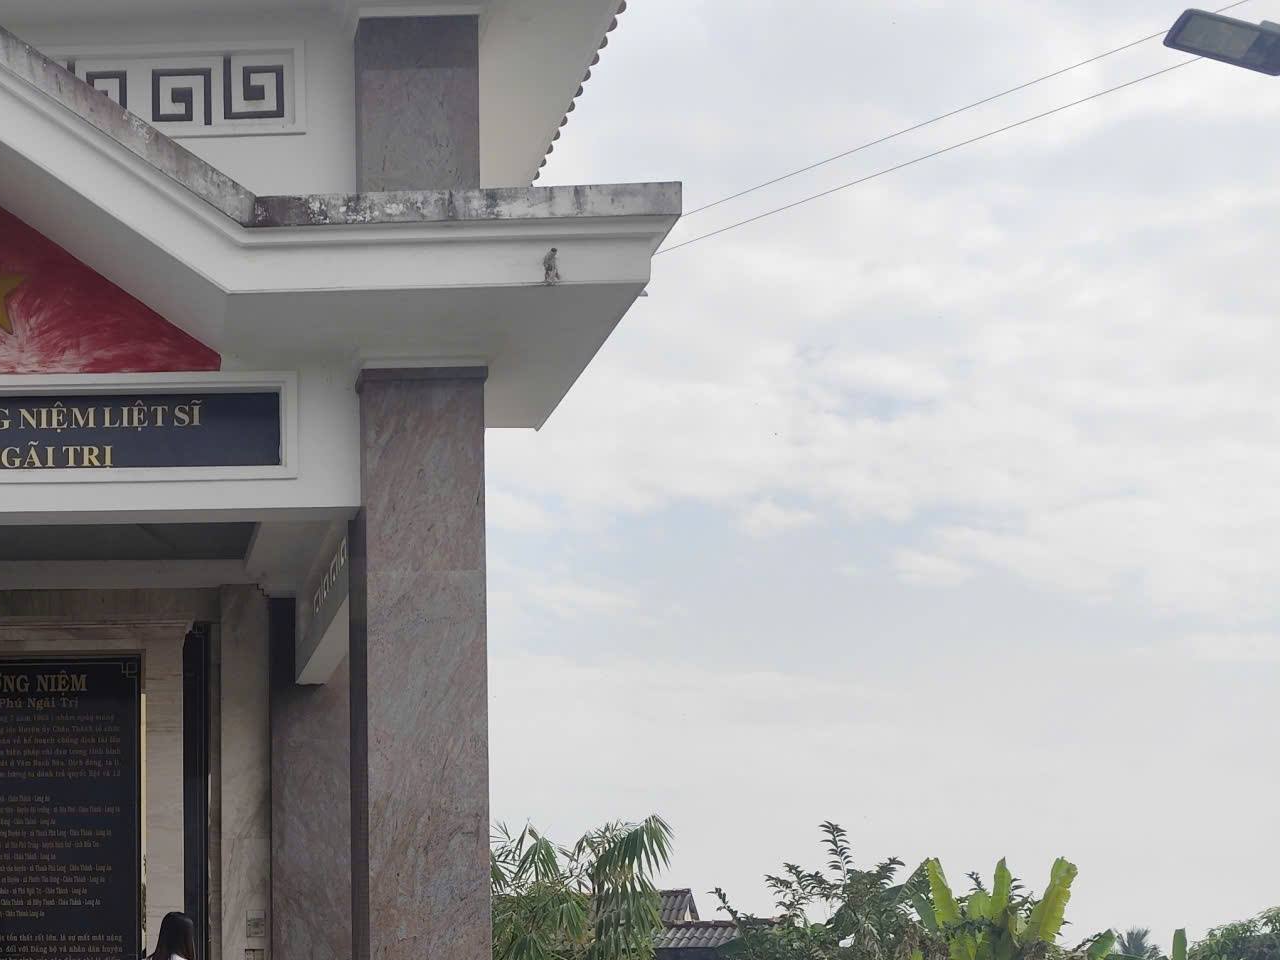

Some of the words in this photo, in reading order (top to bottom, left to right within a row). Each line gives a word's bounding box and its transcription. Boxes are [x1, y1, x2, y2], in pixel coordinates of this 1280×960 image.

[19, 401, 97, 433] NIỆM
[103, 400, 169, 432] LIỆT
[173, 400, 202, 427] SĨ
[62, 445, 113, 469] TRỊ
[36, 670, 88, 696] NIỆM
